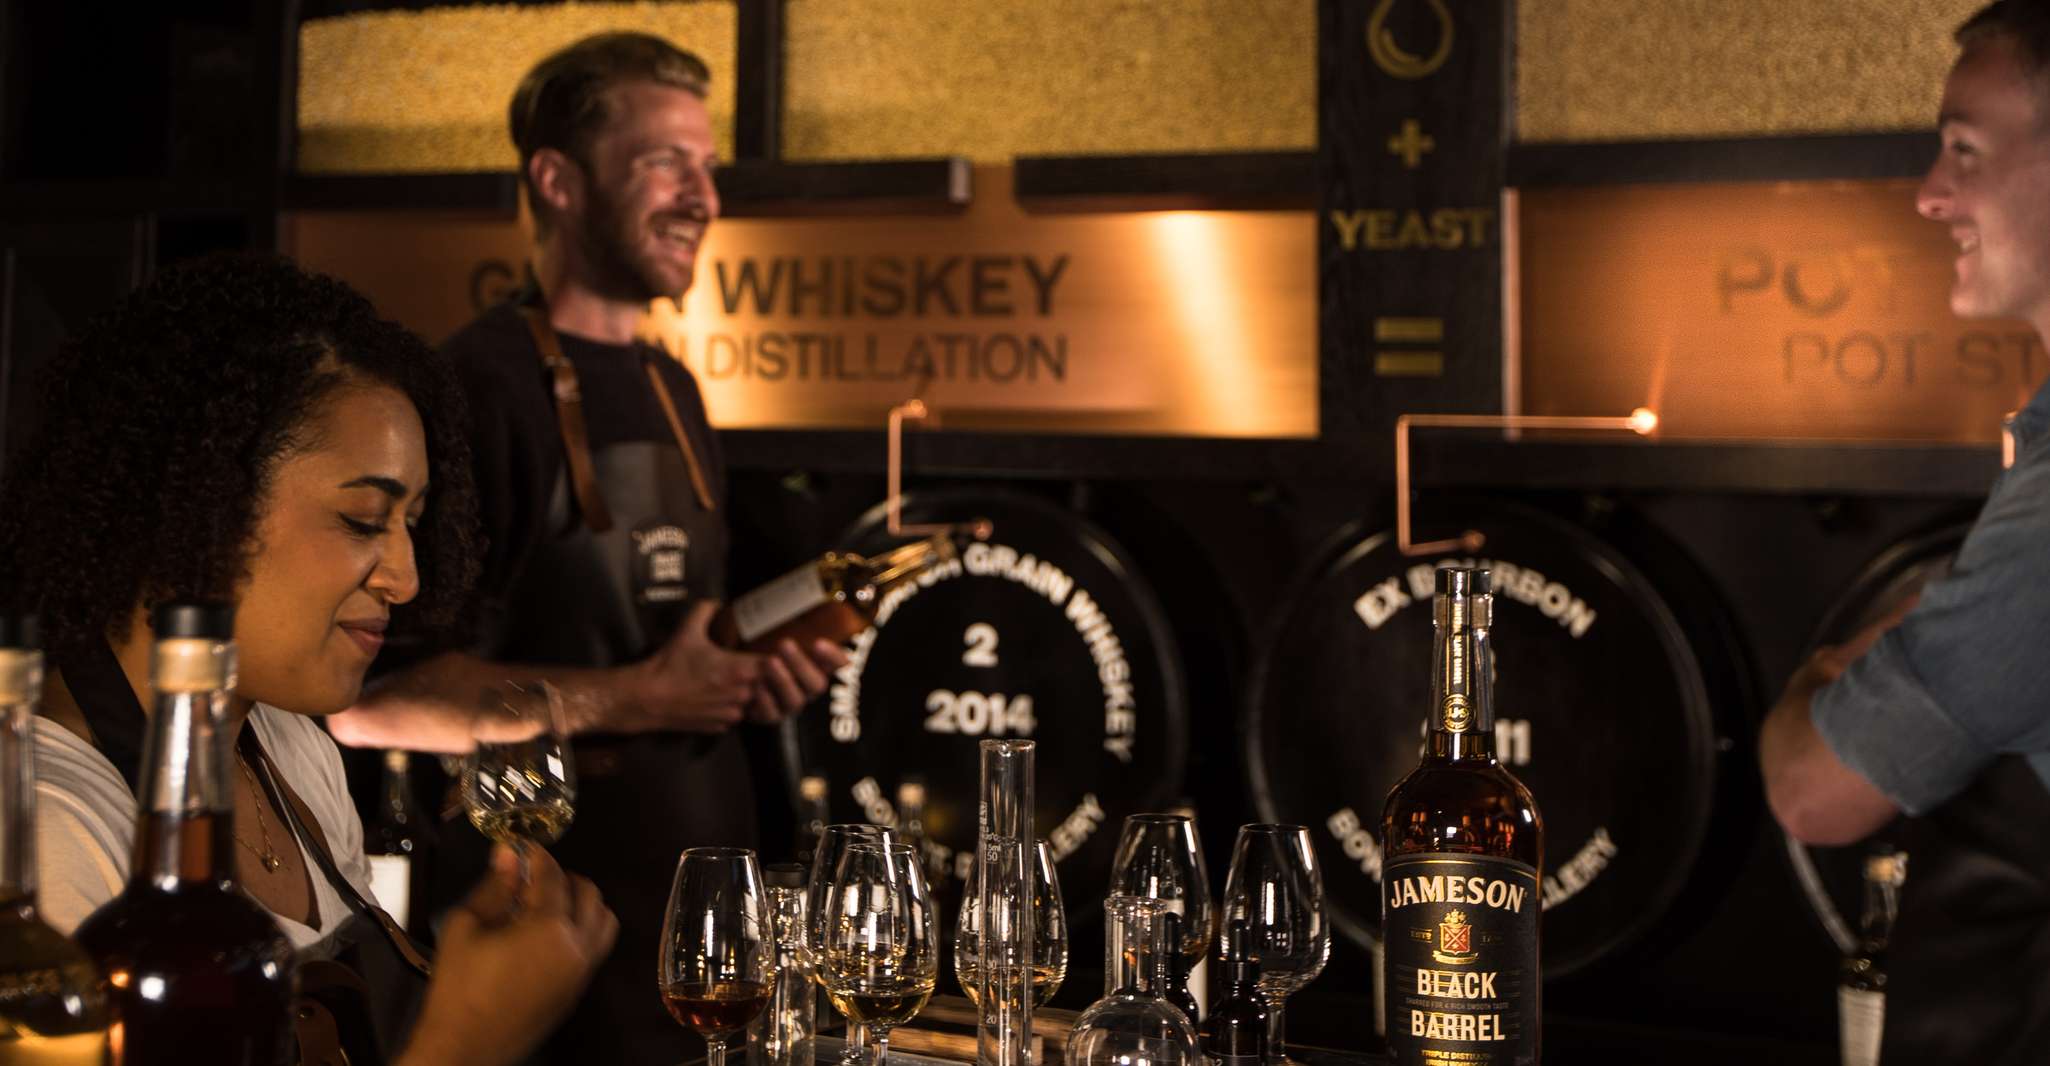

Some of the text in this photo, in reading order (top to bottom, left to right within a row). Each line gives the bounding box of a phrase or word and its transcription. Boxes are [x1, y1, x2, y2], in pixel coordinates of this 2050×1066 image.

[1331, 208, 1492, 249] YEAST
[715, 255, 1069, 318] WHISKEY
[705, 332, 1068, 383] DISTILLATION
[1354, 576, 1411, 630] EX
[1406, 558, 1597, 638] BRBON
[962, 622, 1000, 668] 2
[964, 542, 1075, 606] GRAIN
[1064, 589, 1137, 763] WHISKEY
[923, 689, 1038, 737] 2014
[1391, 875, 1525, 914] JAMESON
[1417, 968, 1498, 999] BLACK
[1411, 1009, 1506, 1042] BARREL
